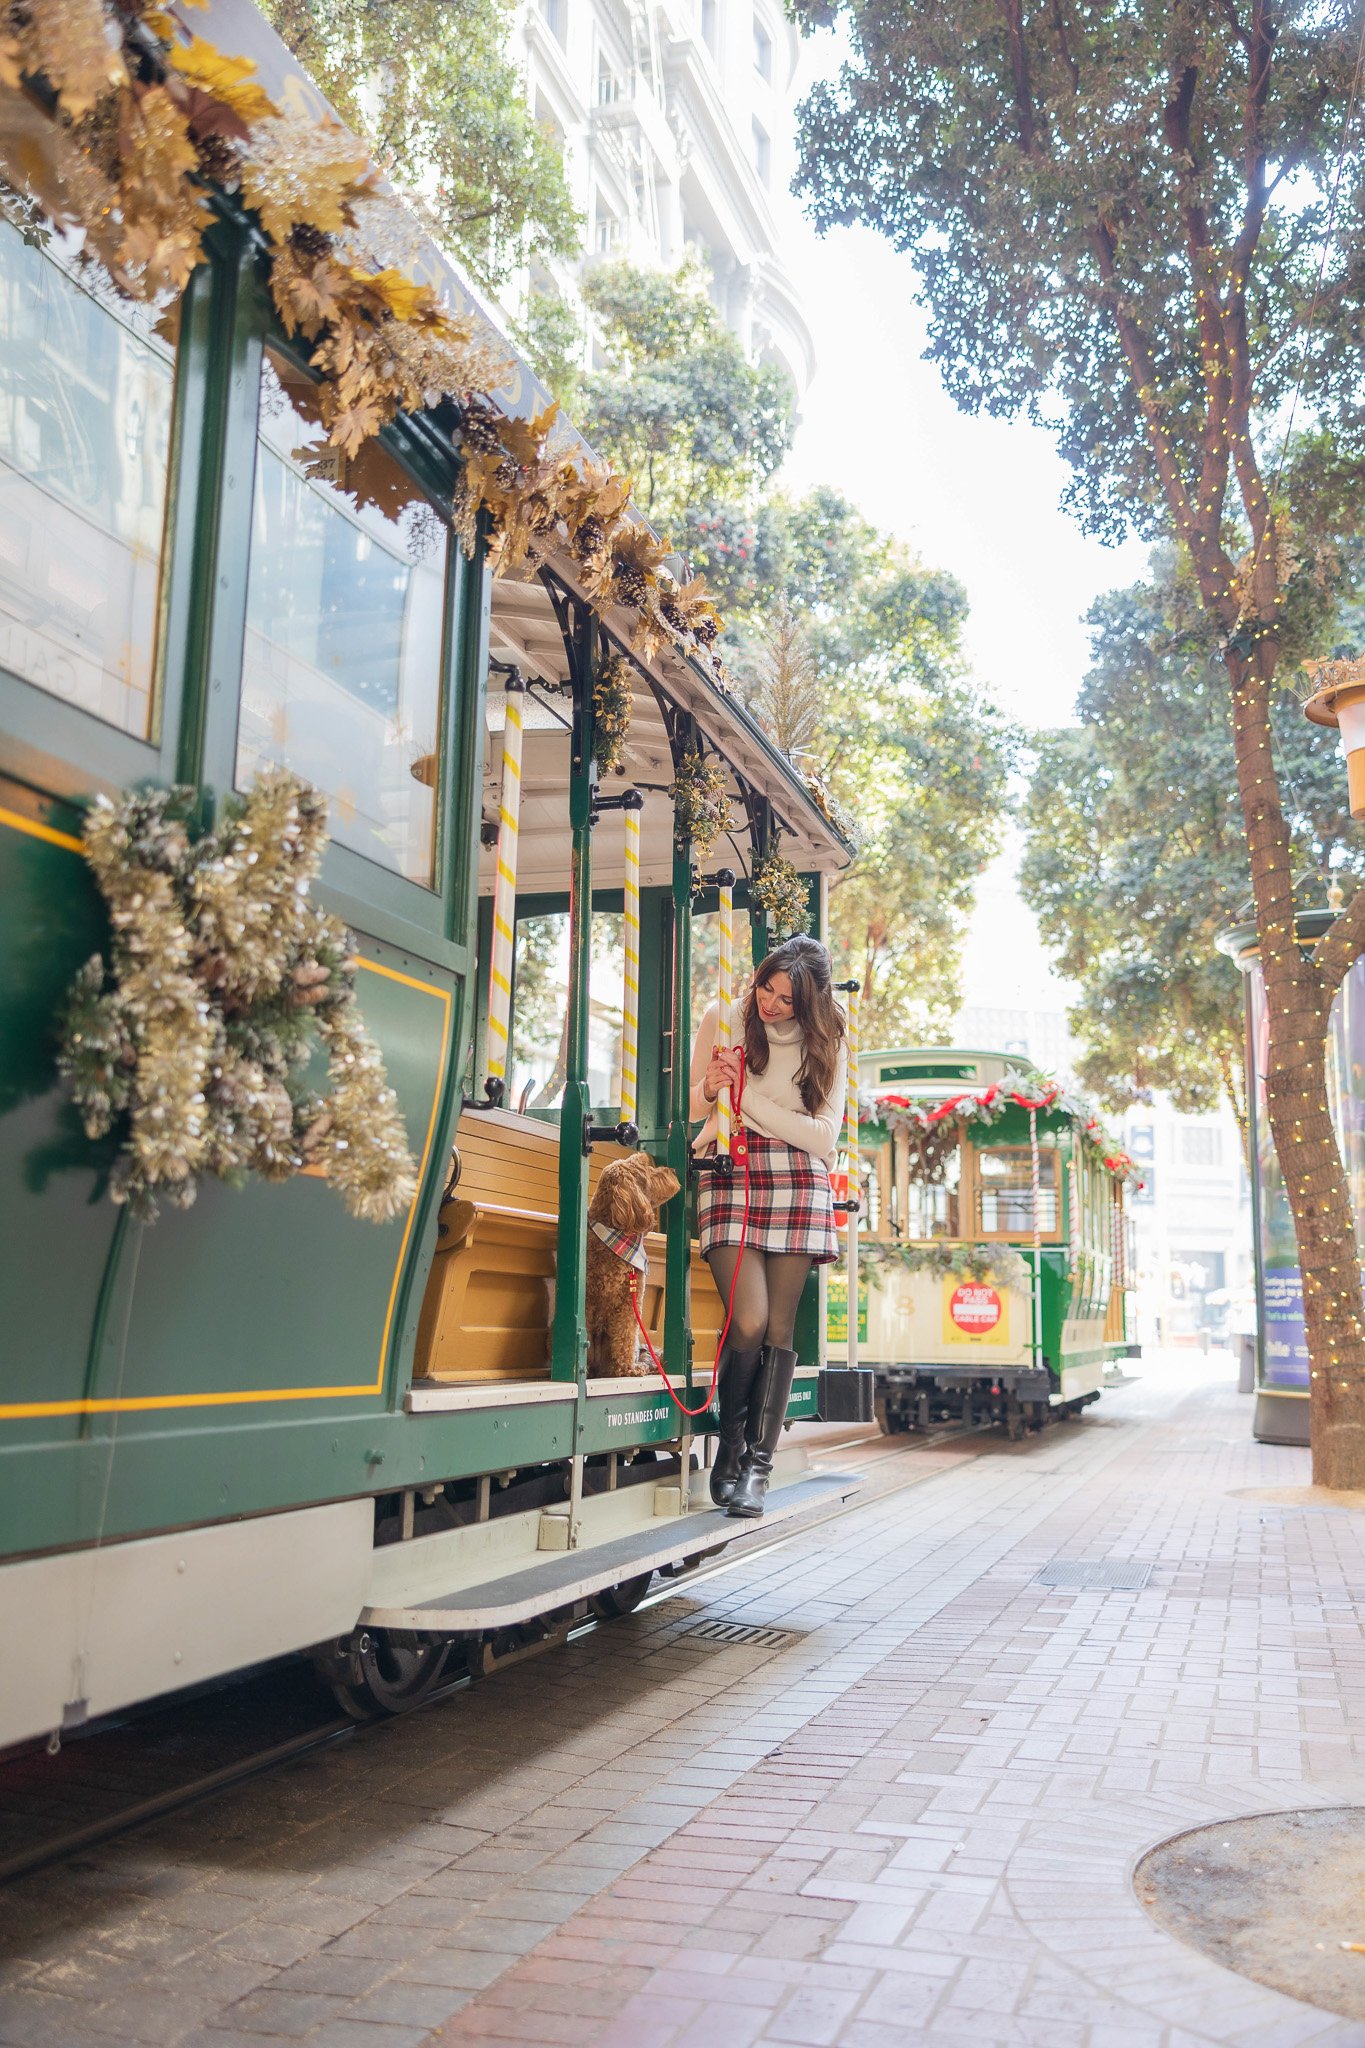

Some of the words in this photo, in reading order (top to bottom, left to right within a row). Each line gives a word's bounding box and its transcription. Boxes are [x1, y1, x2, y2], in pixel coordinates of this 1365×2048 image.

[787, 1391, 802, 1402] ANDEES
[802, 1390, 812, 1401] ONLY
[607, 1413, 622, 1427] TWO
[624, 1409, 653, 1425] STANDEES
[654, 1406, 669, 1420] ONLY
